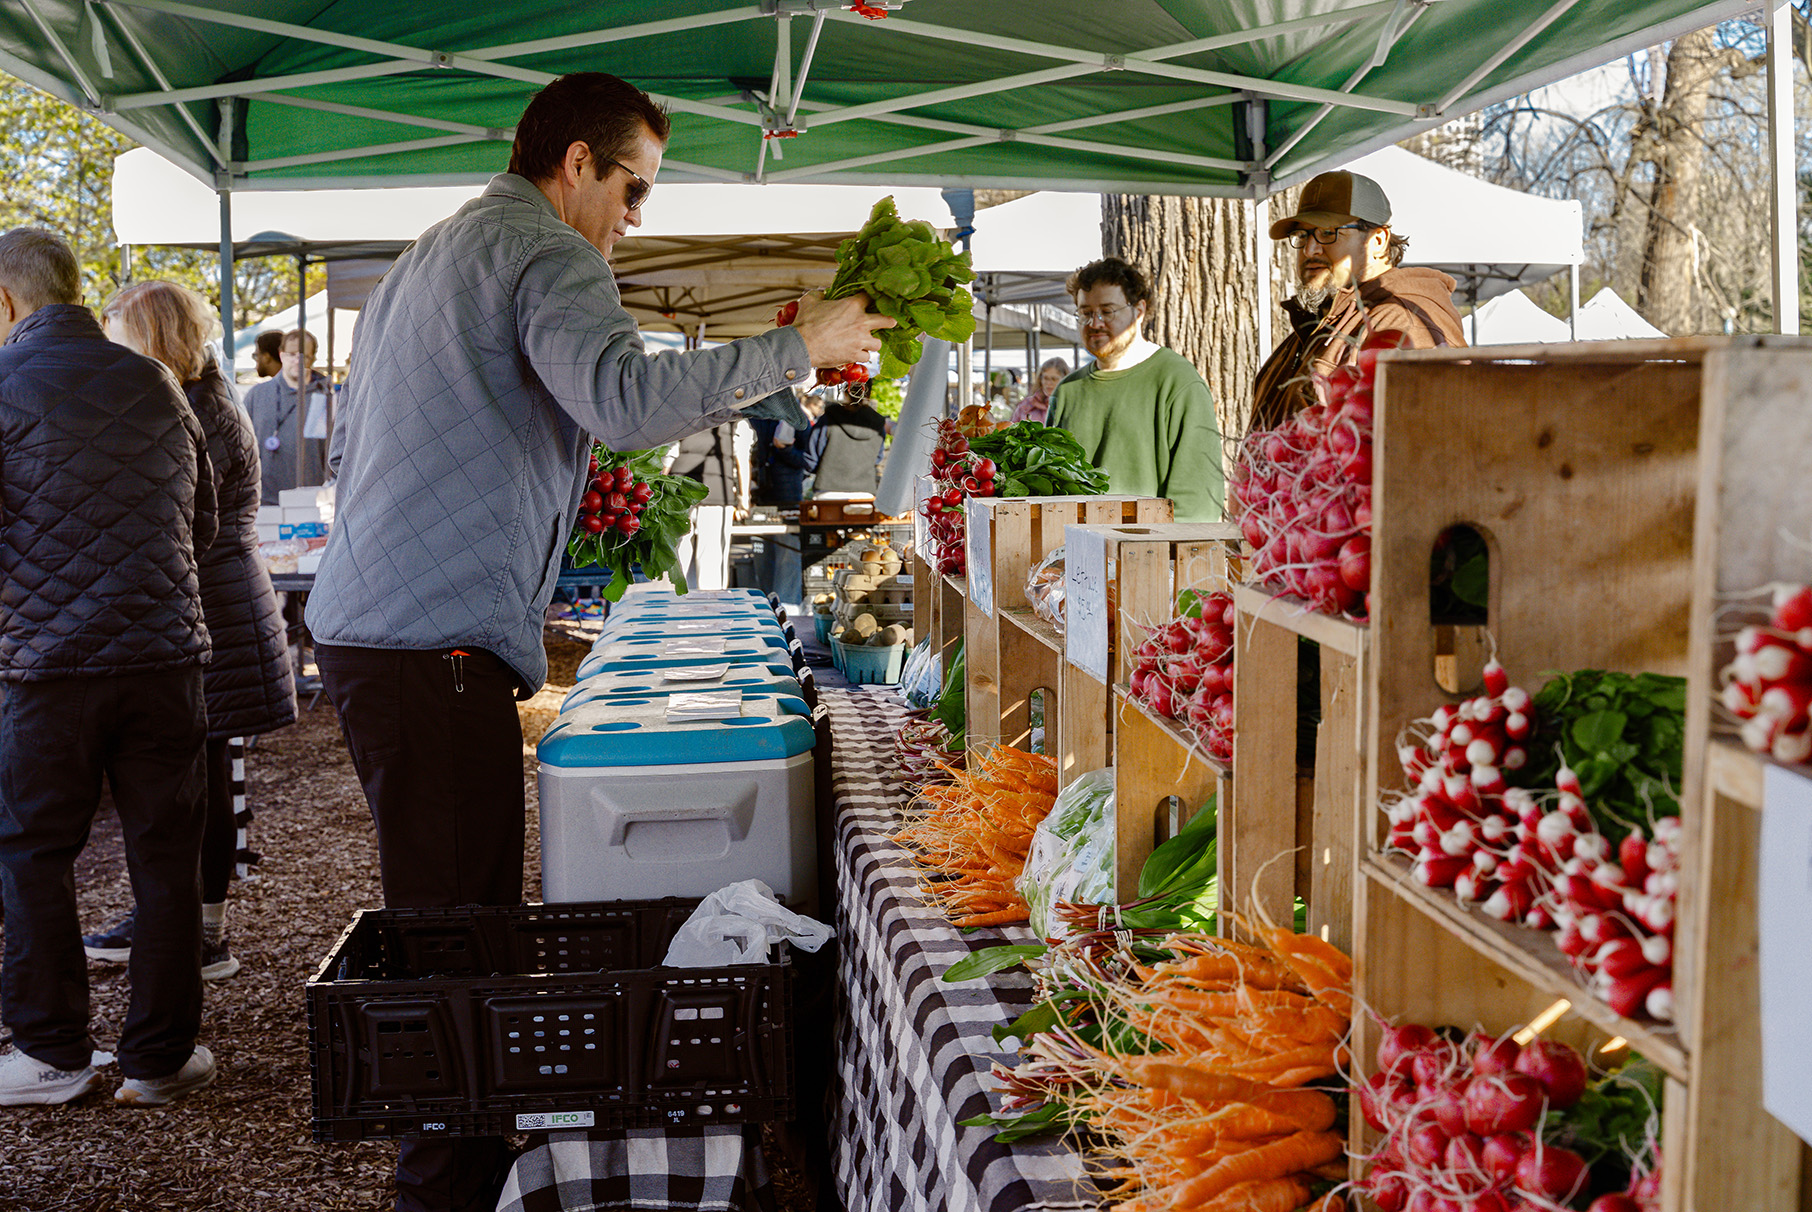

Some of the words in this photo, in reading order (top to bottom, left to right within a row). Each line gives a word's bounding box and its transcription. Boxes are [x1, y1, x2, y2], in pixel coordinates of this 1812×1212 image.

[667, 1110, 685, 1118] 6419
[551, 1114, 579, 1124] IFCO
[423, 1122, 446, 1130] IFCO
